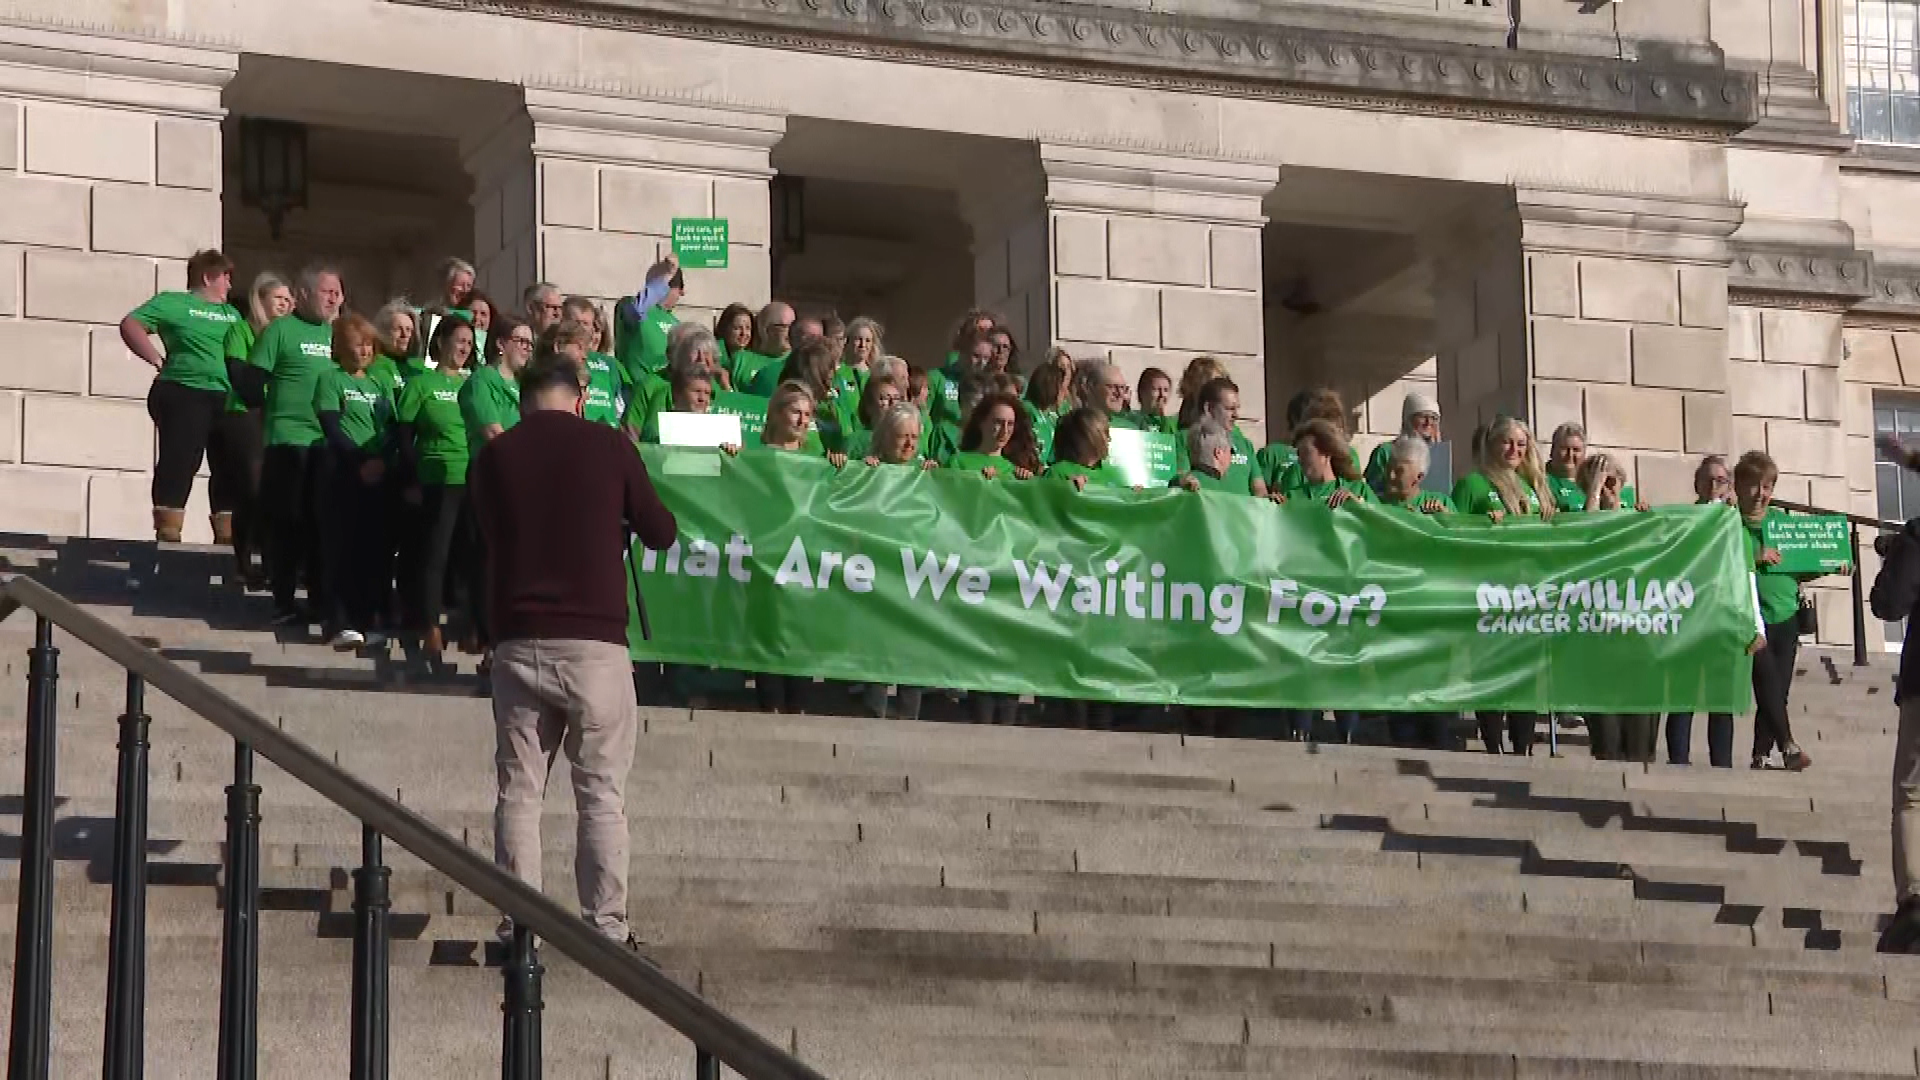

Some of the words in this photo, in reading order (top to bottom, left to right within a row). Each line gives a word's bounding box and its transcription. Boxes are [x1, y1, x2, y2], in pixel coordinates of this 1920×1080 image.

[683, 226, 695, 235] you
[713, 225, 725, 235] get
[675, 234, 691, 242] back
[692, 234, 701, 242] to
[702, 234, 718, 242] work
[680, 243, 701, 252] power
[702, 243, 720, 252] share
[1778, 522, 1796, 531] you
[1825, 521, 1843, 534] get
[1768, 530, 1793, 540] back
[1794, 531, 1807, 540] to
[1808, 530, 1834, 540] work
[1777, 542, 1808, 551] power
[1810, 540, 1839, 550] share
[623, 531, 753, 583] hat
[773, 535, 877, 593] Are
[899, 546, 991, 605] We
[1012, 558, 1247, 636] Waiting
[1266, 577, 1387, 627] For?
[1475, 577, 1695, 614] MACMILLAN
[1475, 613, 1571, 635] CANCER
[1576, 611, 1684, 635] SUPPORT
